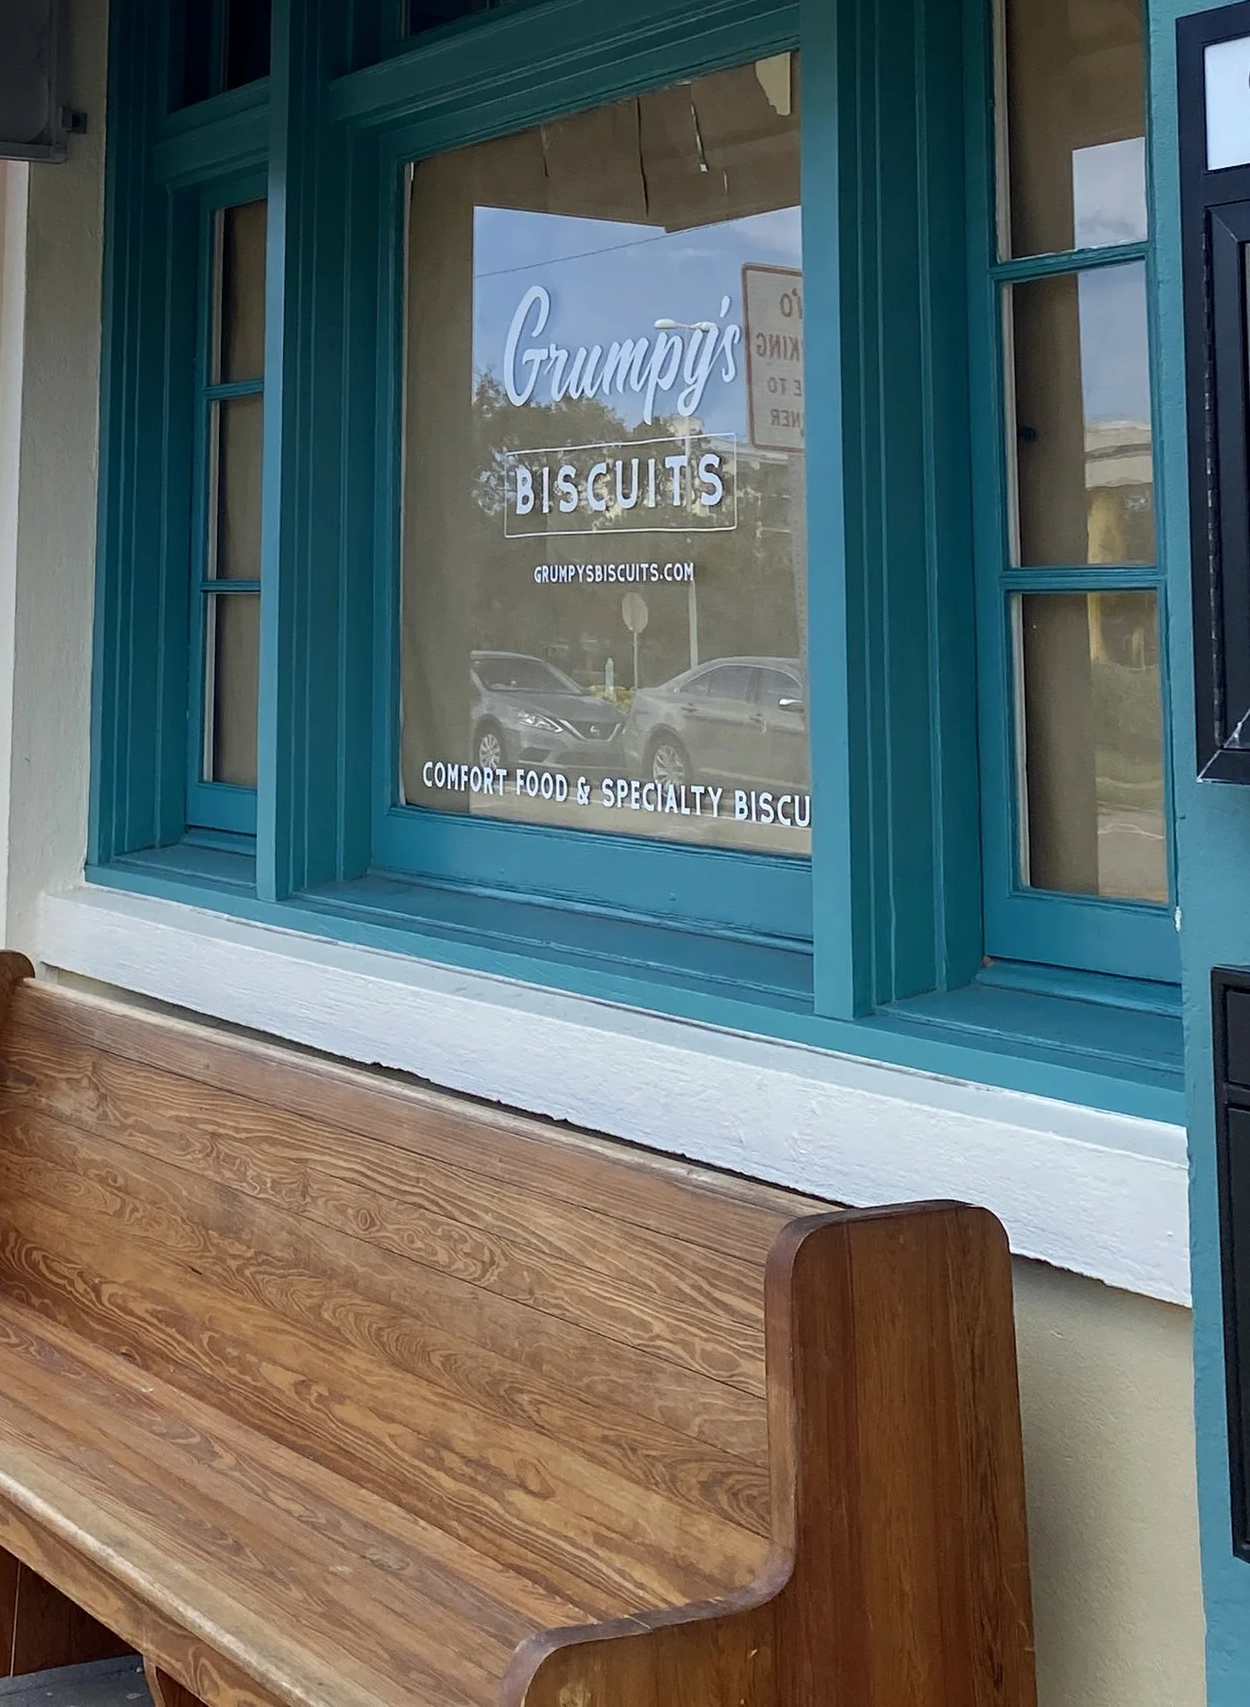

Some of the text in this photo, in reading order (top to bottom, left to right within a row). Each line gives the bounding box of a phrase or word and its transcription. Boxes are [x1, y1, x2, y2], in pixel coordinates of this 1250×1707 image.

[503, 284, 741, 425] Grumpy's
[515, 453, 724, 515] BISCUITS
[533, 562, 694, 584] GRUMPYSBISCUITS.COM
[422, 761, 810, 827] COMFORT FOOD & SPECIALTY BISCU
